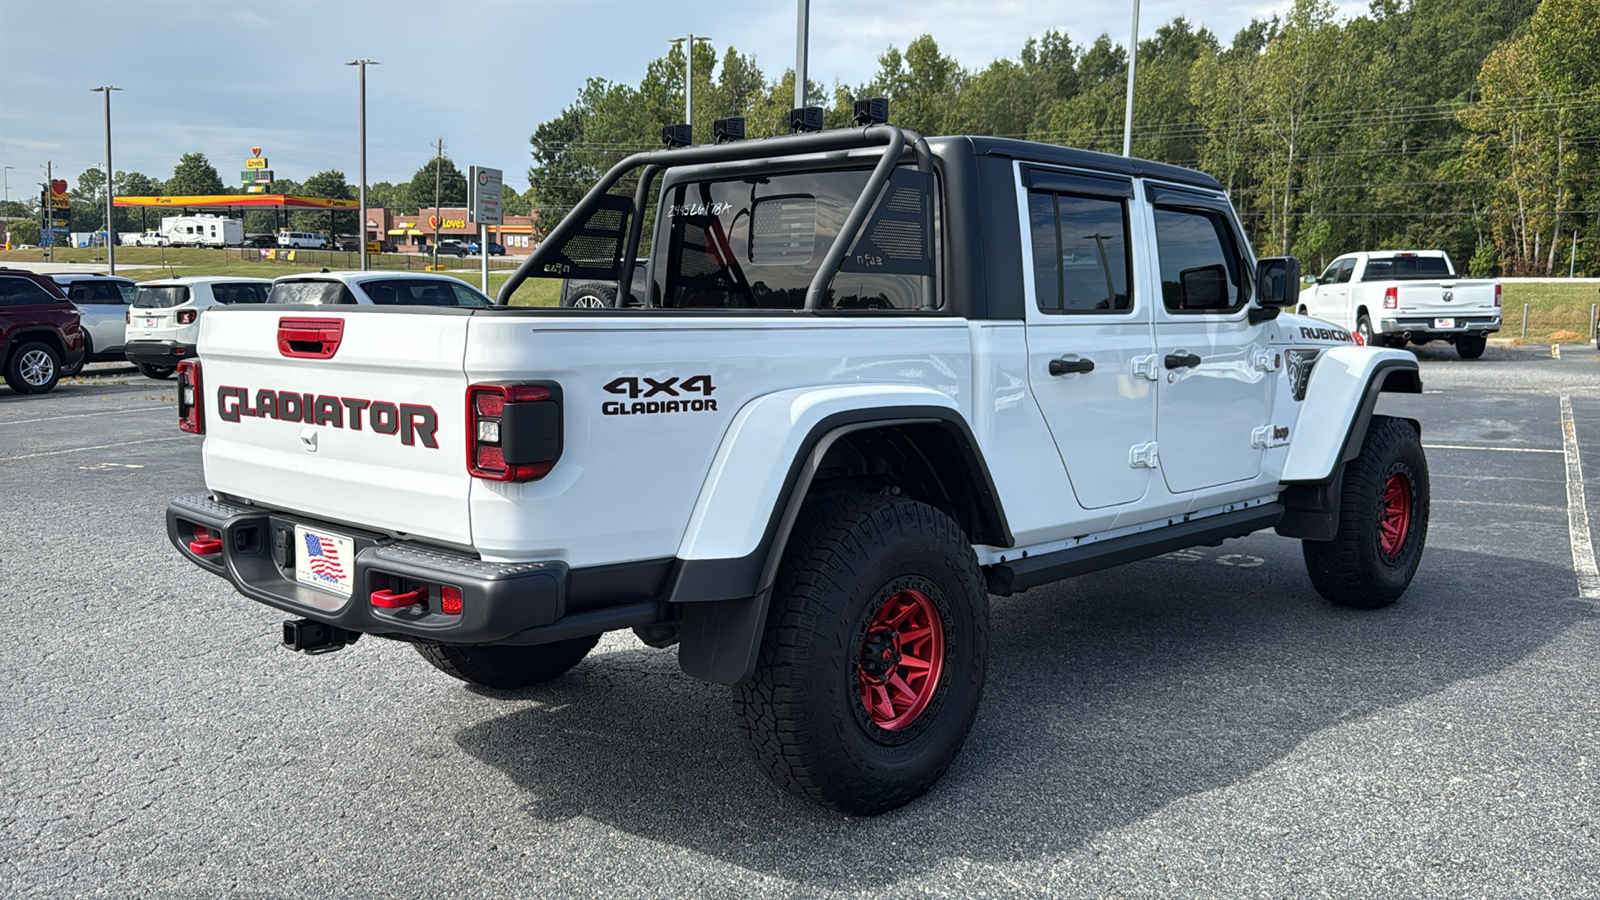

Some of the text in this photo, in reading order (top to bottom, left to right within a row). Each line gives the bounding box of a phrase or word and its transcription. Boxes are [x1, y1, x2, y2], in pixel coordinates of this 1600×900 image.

[1299, 326, 1354, 343] RUBICON
[602, 399, 718, 415] GLADIATOR
[217, 384, 440, 450] GLADIATOR
